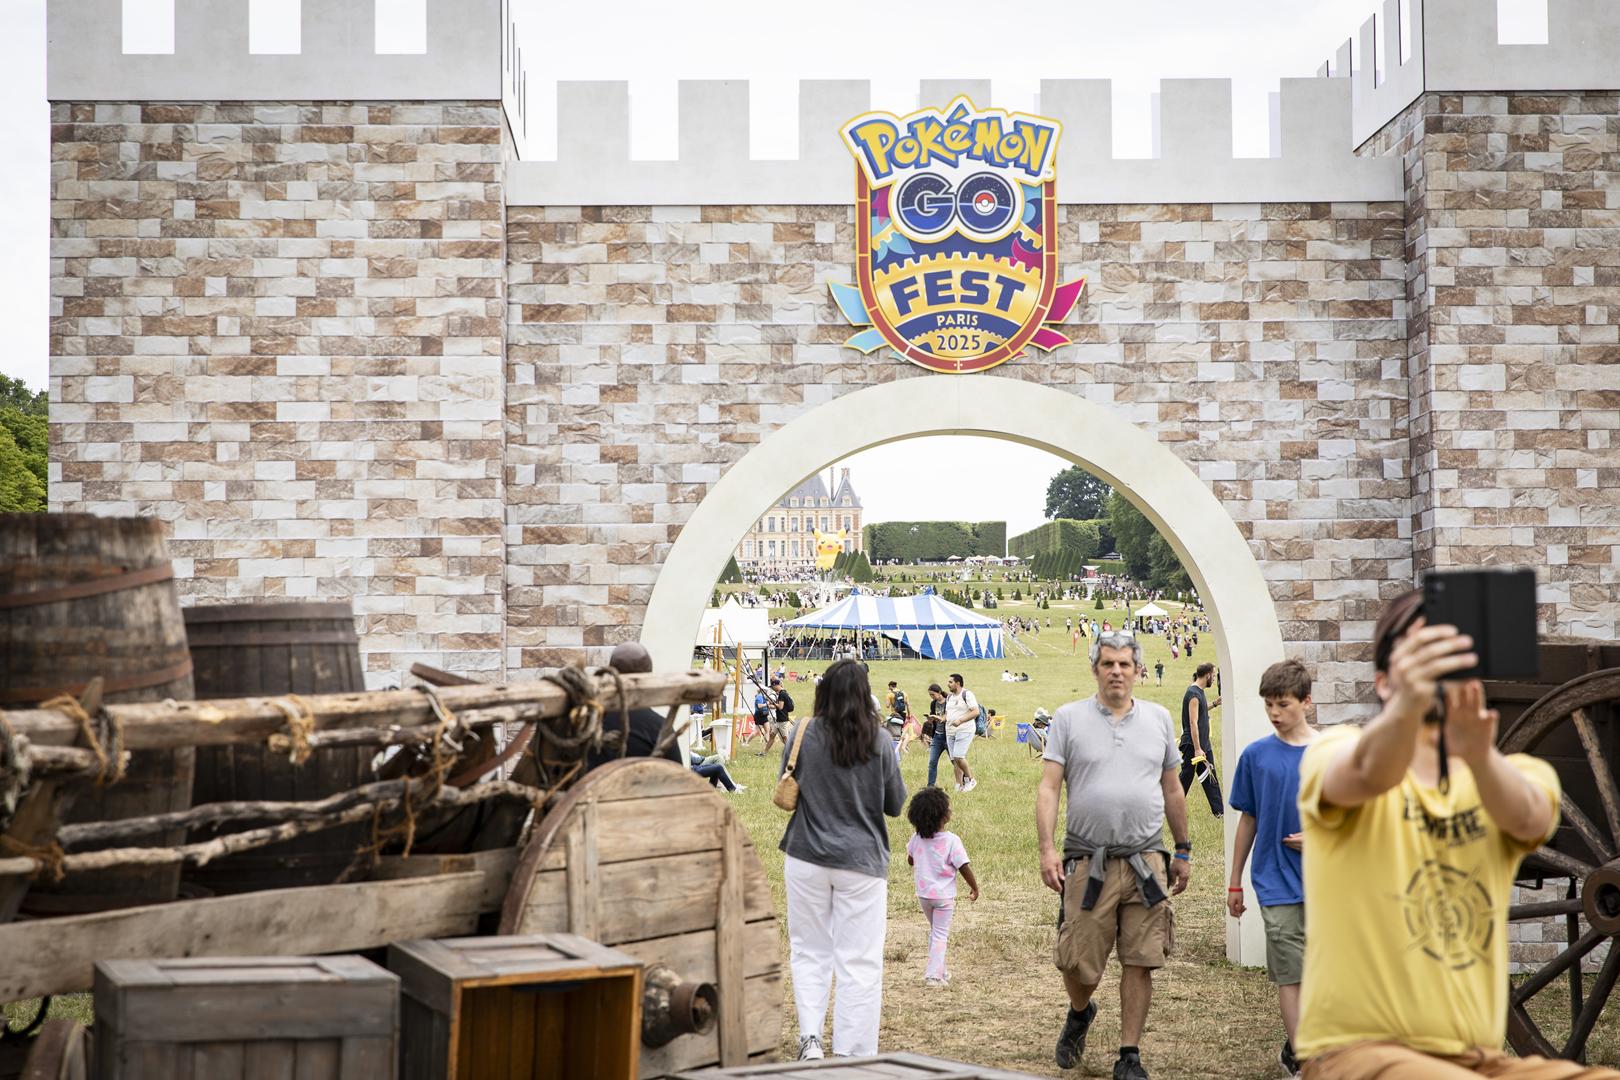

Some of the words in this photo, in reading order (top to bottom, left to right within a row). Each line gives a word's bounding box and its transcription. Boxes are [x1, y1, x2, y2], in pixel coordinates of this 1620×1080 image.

[897, 172, 1016, 235] GO
[889, 270, 1026, 316] FEST
[936, 313, 979, 327] PARIS
[936, 334, 980, 350] 2025
